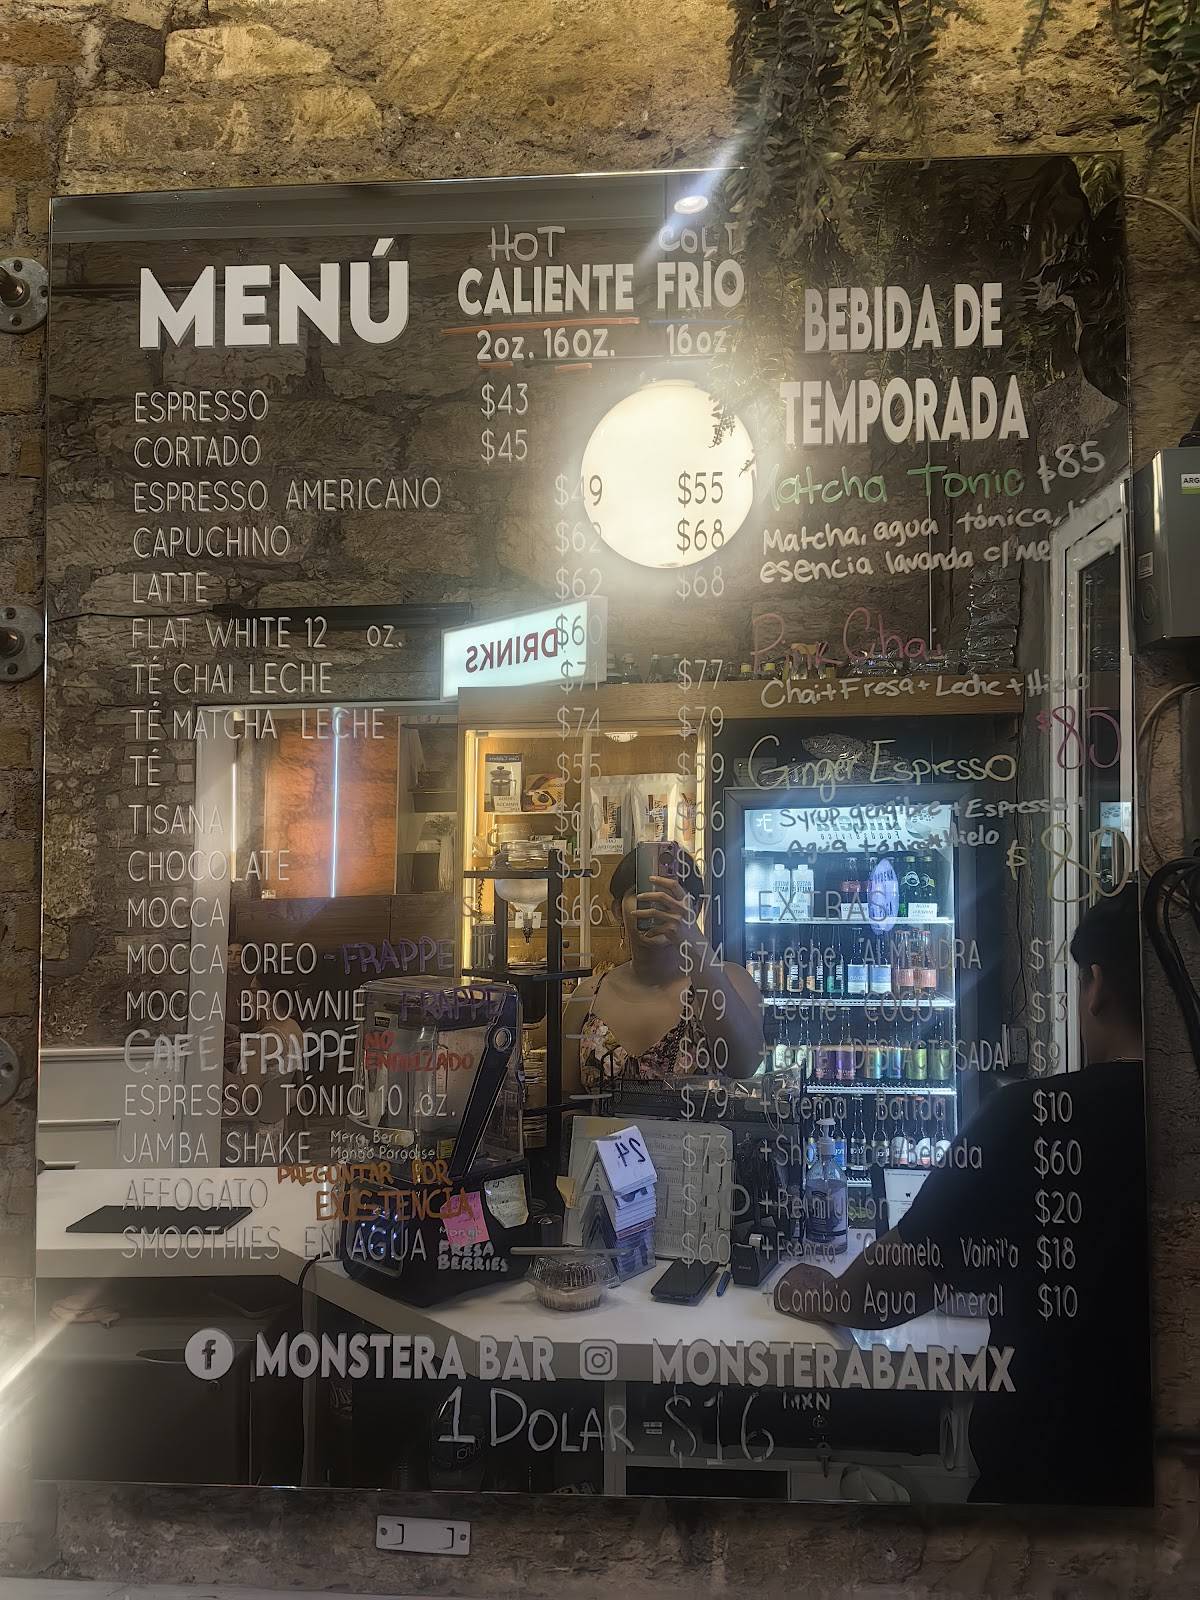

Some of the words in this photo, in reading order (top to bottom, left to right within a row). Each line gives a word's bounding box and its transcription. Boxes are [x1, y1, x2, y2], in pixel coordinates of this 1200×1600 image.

[488, 224, 566, 261] HOT
[139, 237, 410, 350] MENÚ
[457, 263, 635, 316] CALIENTE
[803, 283, 943, 353] BEBIDA
[953, 282, 1003, 349] DE
[134, 390, 269, 423] ESPRESSO
[480, 382, 529, 420] $43
[779, 374, 1030, 447] TEMPORADA
[133, 435, 261, 468] CORTADO
[480, 428, 529, 465] $45
[907, 463, 1024, 499] Tonic
[1036, 440, 1106, 494] $85
[133, 479, 269, 513] ESPRESSO
[285, 477, 442, 512] AMERICANO
[677, 470, 724, 508] $55
[133, 525, 291, 558] CAPUCHINO
[554, 519, 603, 554] $62
[676, 517, 725, 556] $68
[873, 518, 939, 546] agua
[132, 572, 210, 603] LATTE
[554, 565, 603, 601] $62
[675, 565, 725, 600] $68
[759, 556, 874, 583] esencia
[886, 547, 974, 576] lavanda
[131, 617, 191, 649] FLAT
[205, 616, 292, 649] WHITE
[304, 616, 328, 648] 12
[555, 612, 603, 650] $60
[131, 656, 162, 694] TÉ
[172, 663, 234, 694] CHAI
[249, 663, 333, 694] LECHE
[677, 657, 724, 693] $77
[130, 701, 162, 740] TÉ
[172, 709, 278, 741] MATCHA
[301, 708, 385, 740] LECHE
[556, 705, 601, 742] $74
[677, 705, 725, 741] $79
[129, 749, 162, 786] TÉ
[747, 735, 856, 803] Ginger
[868, 738, 1017, 785] Espresso
[128, 804, 225, 835] TISANA
[779, 806, 841, 832] Syrup
[127, 850, 291, 882] CHOCOLATE
[676, 847, 726, 883] $60
[126, 897, 225, 929] MOCCA
[555, 893, 603, 929] $66
[681, 892, 722, 928] $71
[758, 890, 890, 923] EXTRAS
[126, 943, 225, 975] MOCCA
[240, 942, 317, 976] OREO
[679, 939, 725, 976] $74
[126, 990, 224, 1021] MOCCA
[240, 989, 367, 1022] BROWNIE
[680, 989, 727, 1023] $79
[124, 1025, 218, 1075] CAFÉ
[239, 1024, 361, 1075] FRAPPÉ
[679, 1037, 729, 1073] $60
[123, 1083, 263, 1118] ESPRESSO
[280, 1074, 366, 1118] TÓNIC
[378, 1083, 403, 1117] 10
[680, 1083, 729, 1120] $79
[1032, 1089, 1074, 1127] $10
[122, 1131, 210, 1165] JAMBA
[224, 1130, 311, 1165] SHAKE
[682, 1134, 728, 1168] $73
[1033, 1136, 1083, 1179] $60
[411, 1159, 453, 1186] POR
[121, 1178, 270, 1212] AFFOGATO
[1034, 1189, 1083, 1229] $20
[120, 1227, 282, 1261] SMOOTHIES
[304, 1226, 338, 1261] EN
[350, 1227, 428, 1262] AGUA
[681, 1232, 731, 1269] $60
[1036, 1234, 1077, 1274] $18
[437, 1254, 508, 1273] BERRIES
[863, 1282, 916, 1322] Agua
[933, 1283, 1004, 1317] Mineral
[1037, 1283, 1078, 1321] $10
[255, 1330, 468, 1381] MONSTERA
[479, 1334, 557, 1382] BAR
[652, 1338, 1017, 1393] MONSTERABARMX
[437, 1386, 476, 1443] 1
